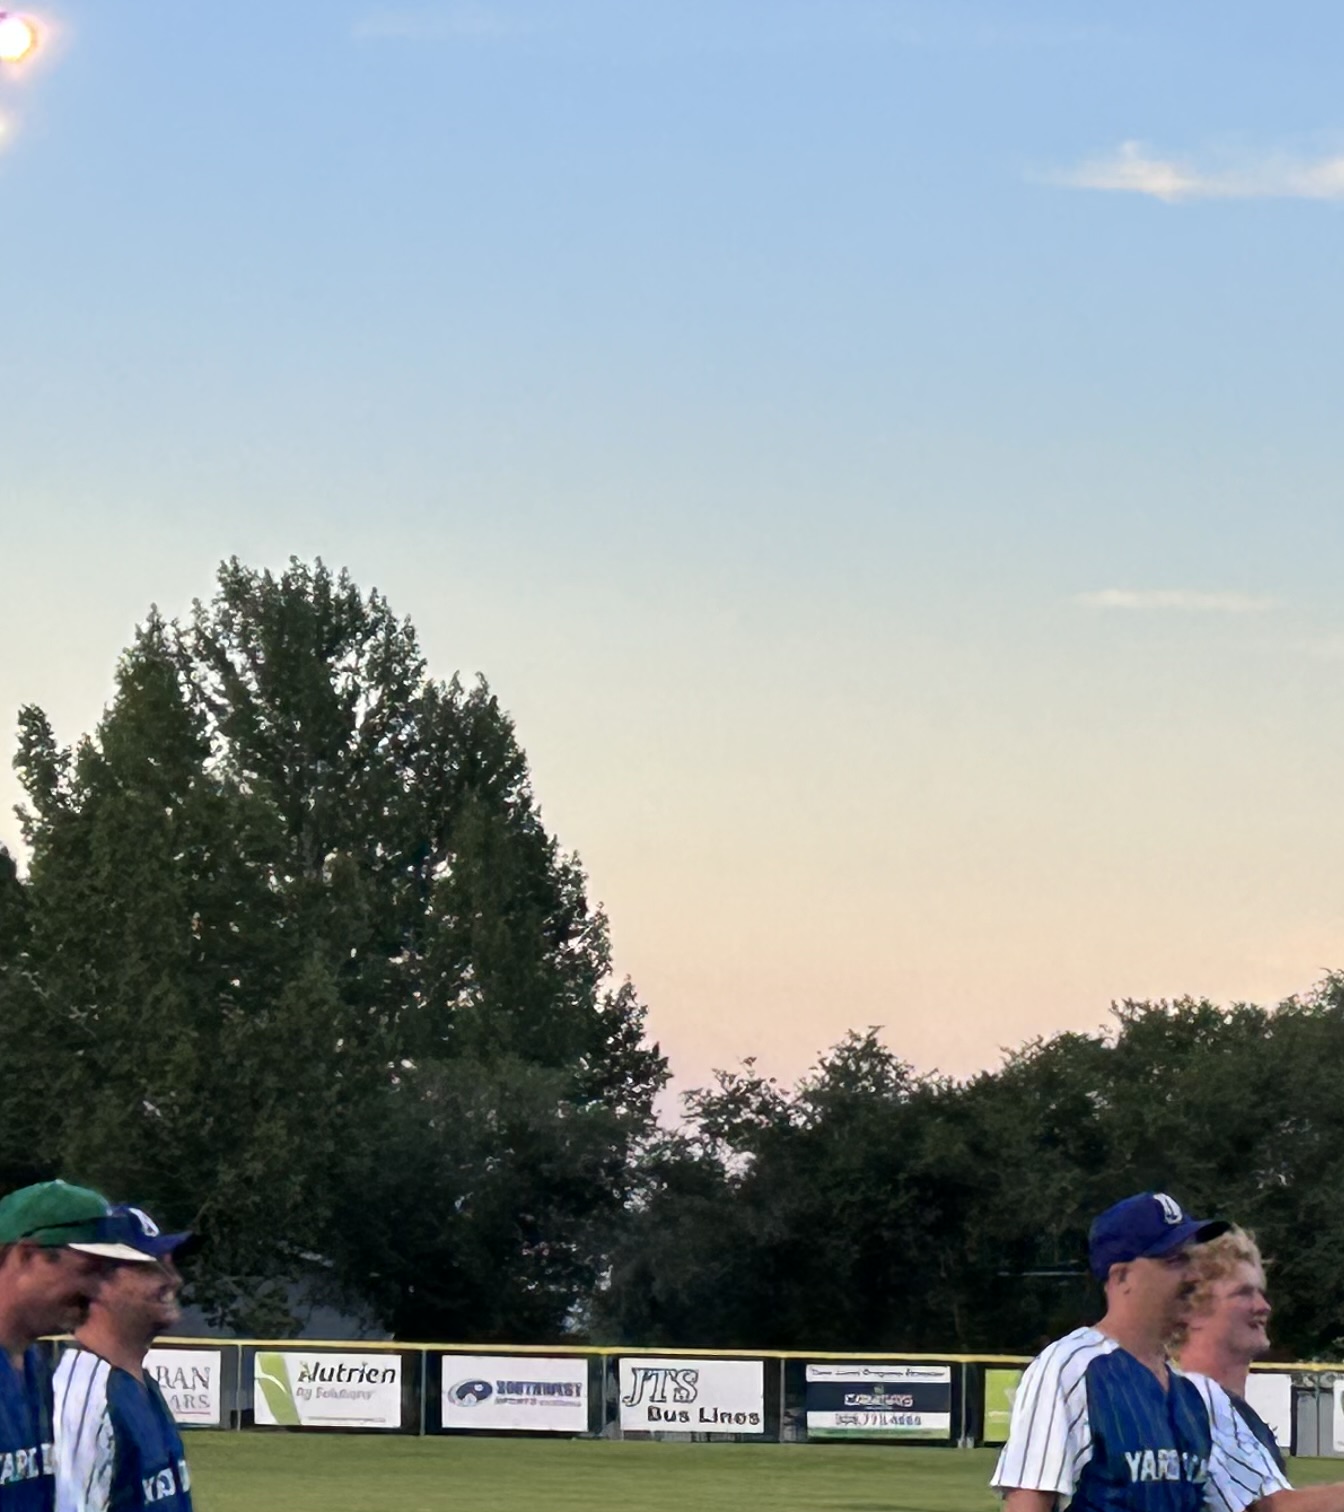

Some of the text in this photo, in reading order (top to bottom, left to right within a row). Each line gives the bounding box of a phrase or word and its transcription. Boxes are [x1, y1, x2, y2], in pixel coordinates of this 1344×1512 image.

[297, 1361, 396, 1384] Nutrien
[622, 1367, 698, 1406] JTS
[647, 1406, 761, 1425] Bus Lines
